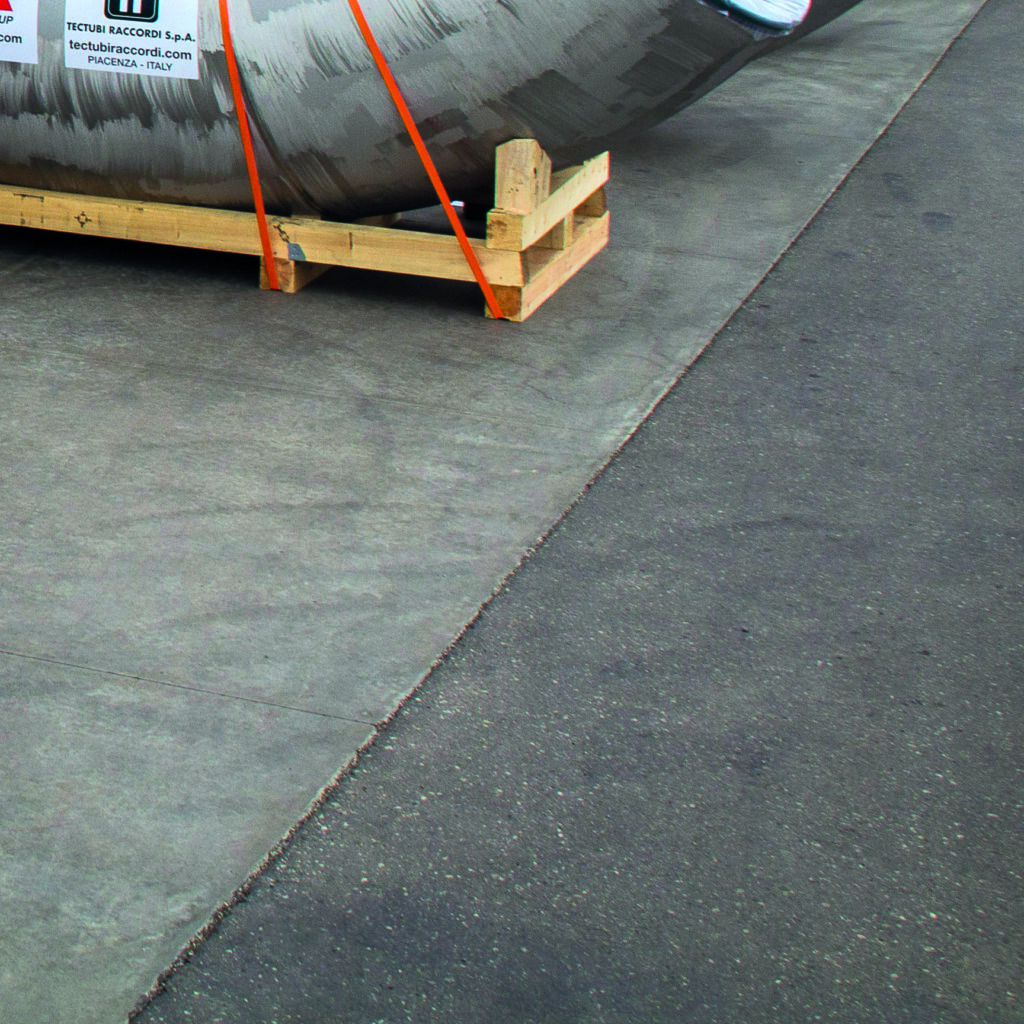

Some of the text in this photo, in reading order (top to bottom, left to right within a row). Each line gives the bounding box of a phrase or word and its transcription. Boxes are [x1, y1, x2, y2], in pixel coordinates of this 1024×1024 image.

[67, 22, 196, 43] TECTUBI RACCORDI S.p.A.
[69, 39, 192, 60] tectubiraccordi.com
[88, 55, 138, 69] PIACENZA
[146, 60, 173, 72] ITALY
